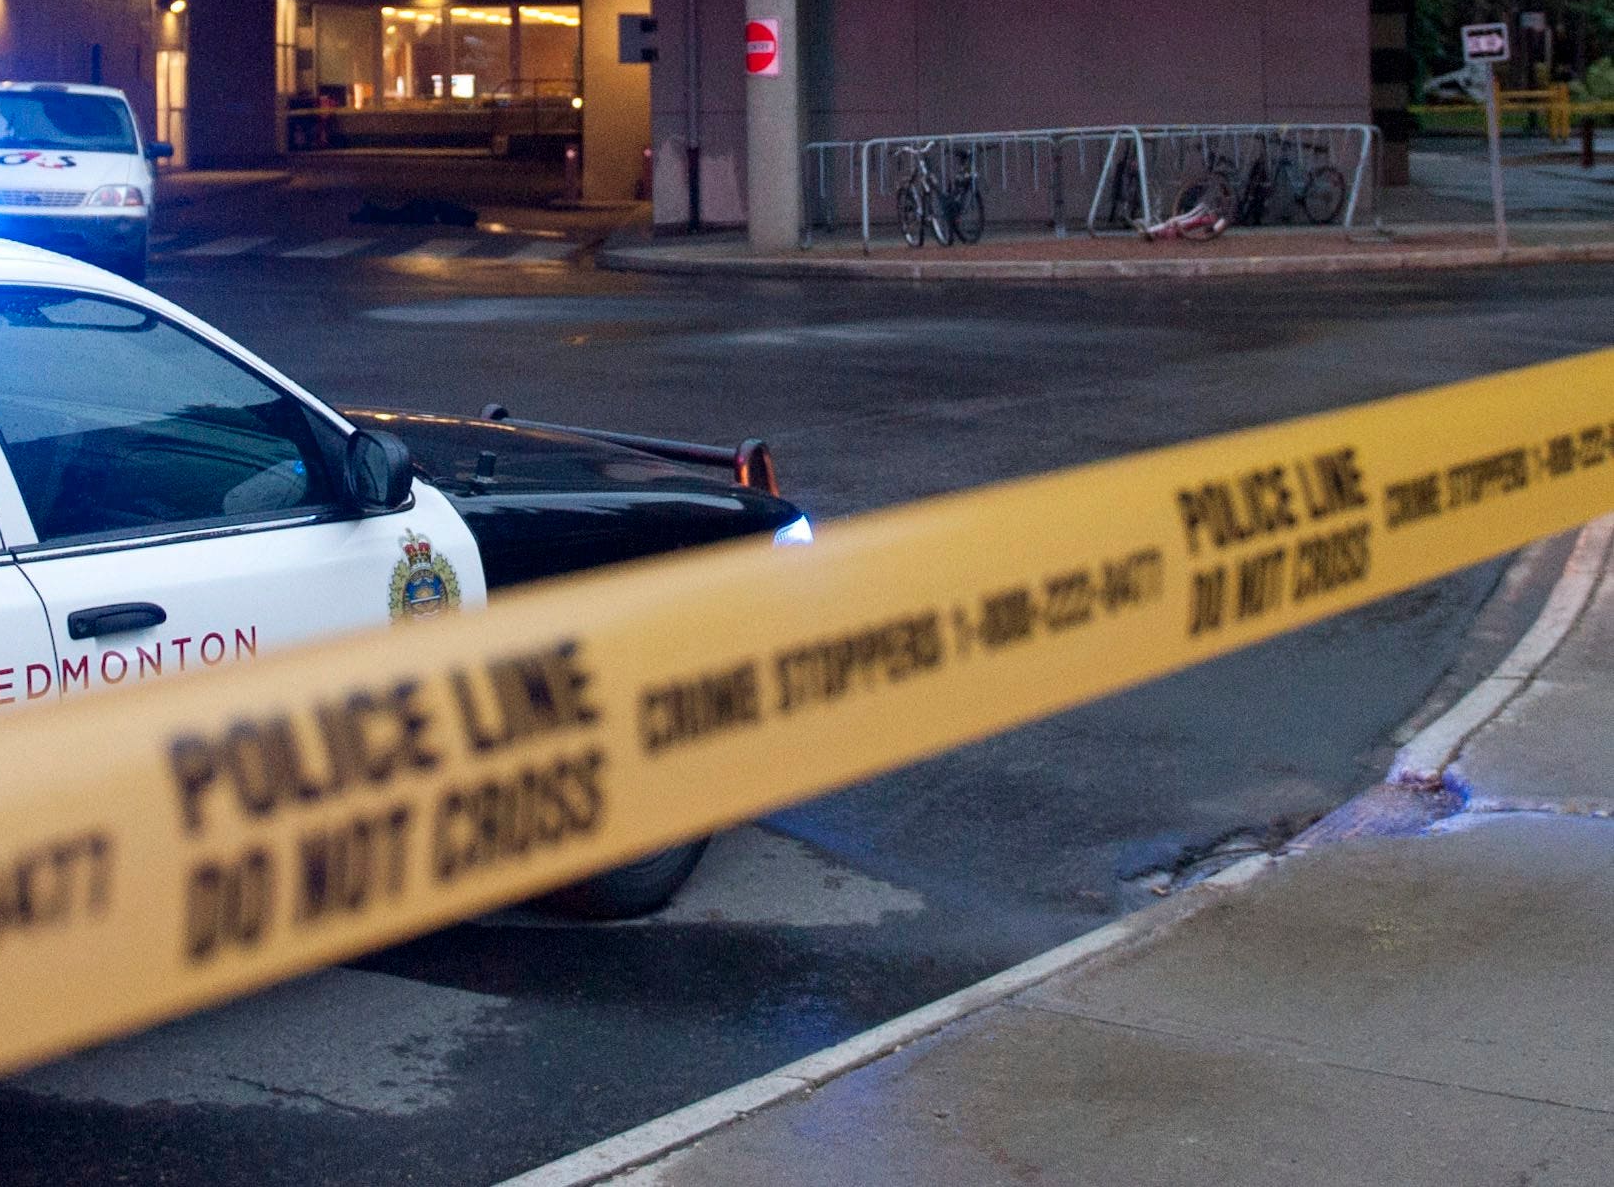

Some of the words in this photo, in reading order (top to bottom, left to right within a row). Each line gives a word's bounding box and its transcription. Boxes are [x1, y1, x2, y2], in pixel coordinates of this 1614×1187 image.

[1176, 465, 1297, 556] POLICE
[1295, 445, 1369, 520] LINE
[1189, 566, 1228, 639] DO
[1237, 548, 1286, 621] NOT
[1293, 522, 1372, 603] CROSS
[169, 674, 438, 834] POLICE
[449, 639, 599, 753] LINE
[183, 846, 273, 965] DO
[297, 805, 414, 923] NOT
[429, 746, 605, 884] CROSS
